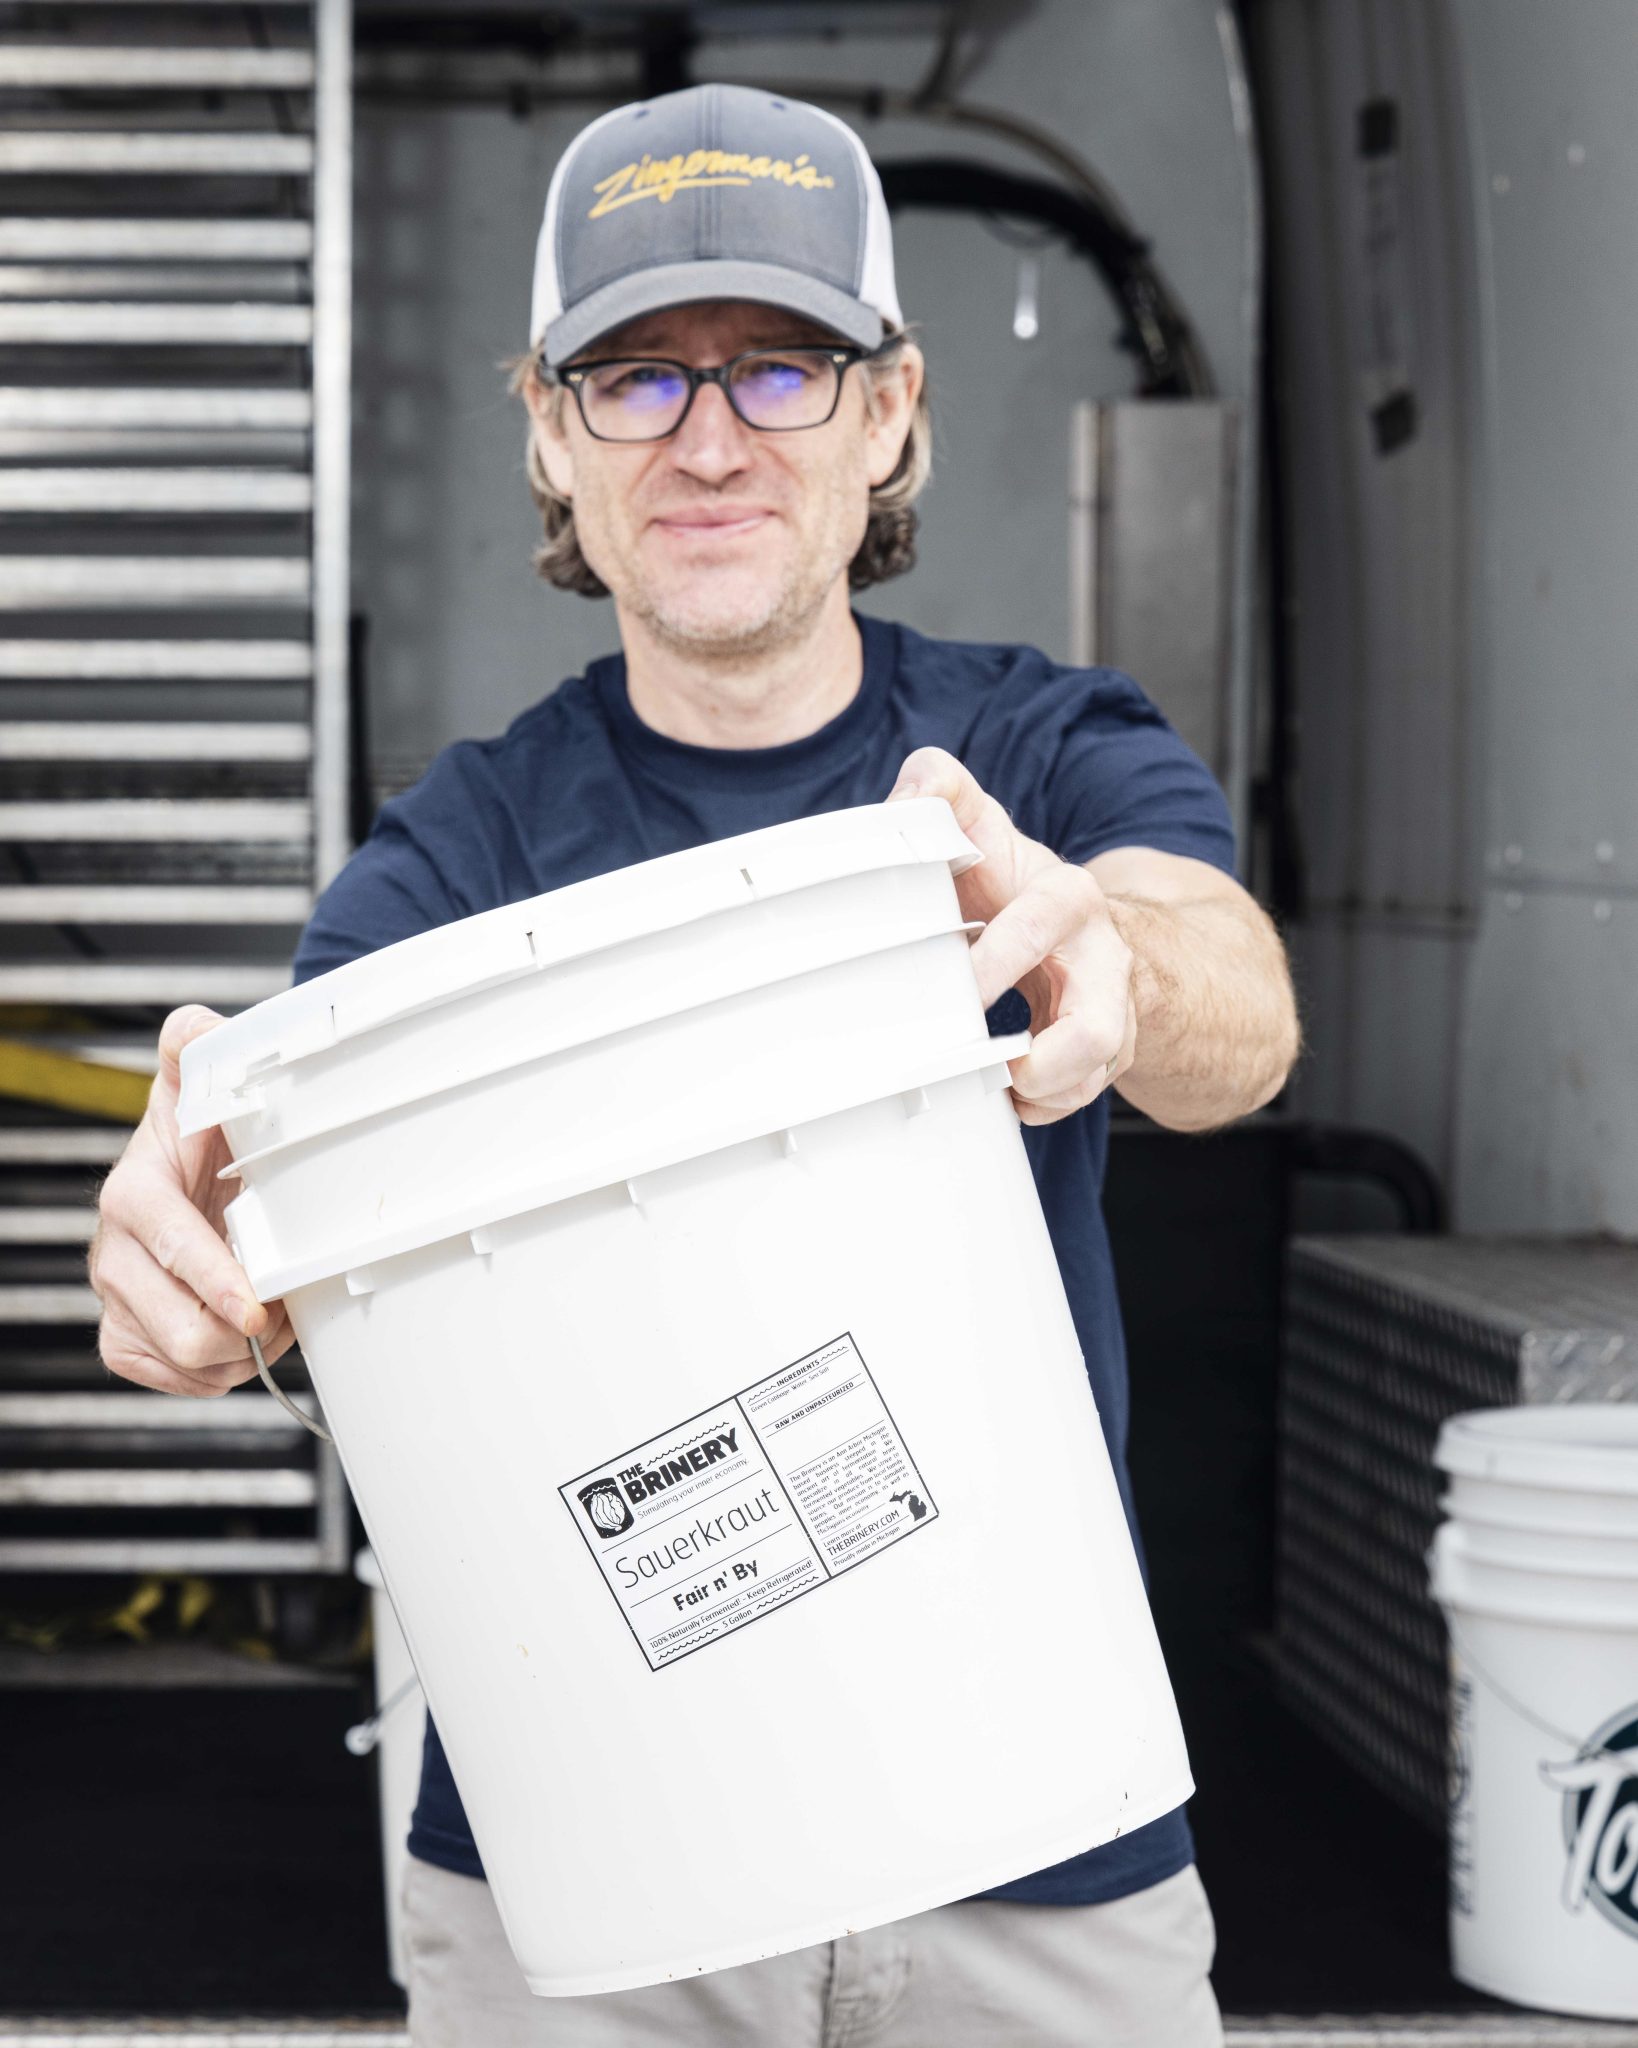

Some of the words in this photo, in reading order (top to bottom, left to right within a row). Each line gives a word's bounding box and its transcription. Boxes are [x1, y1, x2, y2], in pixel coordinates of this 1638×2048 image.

[588, 150, 834, 219] Zingerman's
[776, 1359, 820, 1387] INGREDIENTS
[774, 1418, 790, 1430] RAW
[791, 1410, 805, 1421] AND
[803, 1381, 855, 1413] UNPASTEURIZED
[616, 1462, 646, 1484] THE
[623, 1427, 739, 1505] BRINERY
[789, 1475, 801, 1483] The
[801, 1464, 821, 1477] Brinery
[836, 1449, 847, 1457] Ann
[848, 1440, 862, 1451] Arbor
[863, 1426, 886, 1442] Michigan
[793, 1477, 811, 1490] based
[815, 1462, 839, 1478] business
[844, 1446, 866, 1461] steeped
[880, 1432, 889, 1440] the
[637, 1495, 679, 1519] Stimulating
[678, 1486, 694, 1499] your
[695, 1476, 713, 1490] inner
[803, 1490, 833, 1509] fermented
[821, 1475, 830, 1483] art
[837, 1484, 859, 1500] produce
[833, 1501, 844, 1510] Our
[615, 1489, 780, 1589] Sauerkraut
[823, 1536, 840, 1548] Learn
[840, 1528, 855, 1538] more
[826, 1509, 900, 1556] THEBRINERY.COM
[833, 1553, 855, 1567] Proudly
[856, 1544, 871, 1555] made
[876, 1526, 900, 1542] Michigan
[649, 1636, 669, 1649] 100%
[668, 1620, 701, 1640] Naturally
[700, 1598, 741, 1624] Fermented!
[746, 1586, 767, 1600] Keep
[765, 1559, 813, 1590] Refrigerated!
[672, 1584, 709, 1611] Fair
[713, 1570, 727, 1592] n'
[731, 1560, 758, 1581] By
[722, 1620, 729, 1628] 5
[728, 1609, 753, 1625] Gallon
